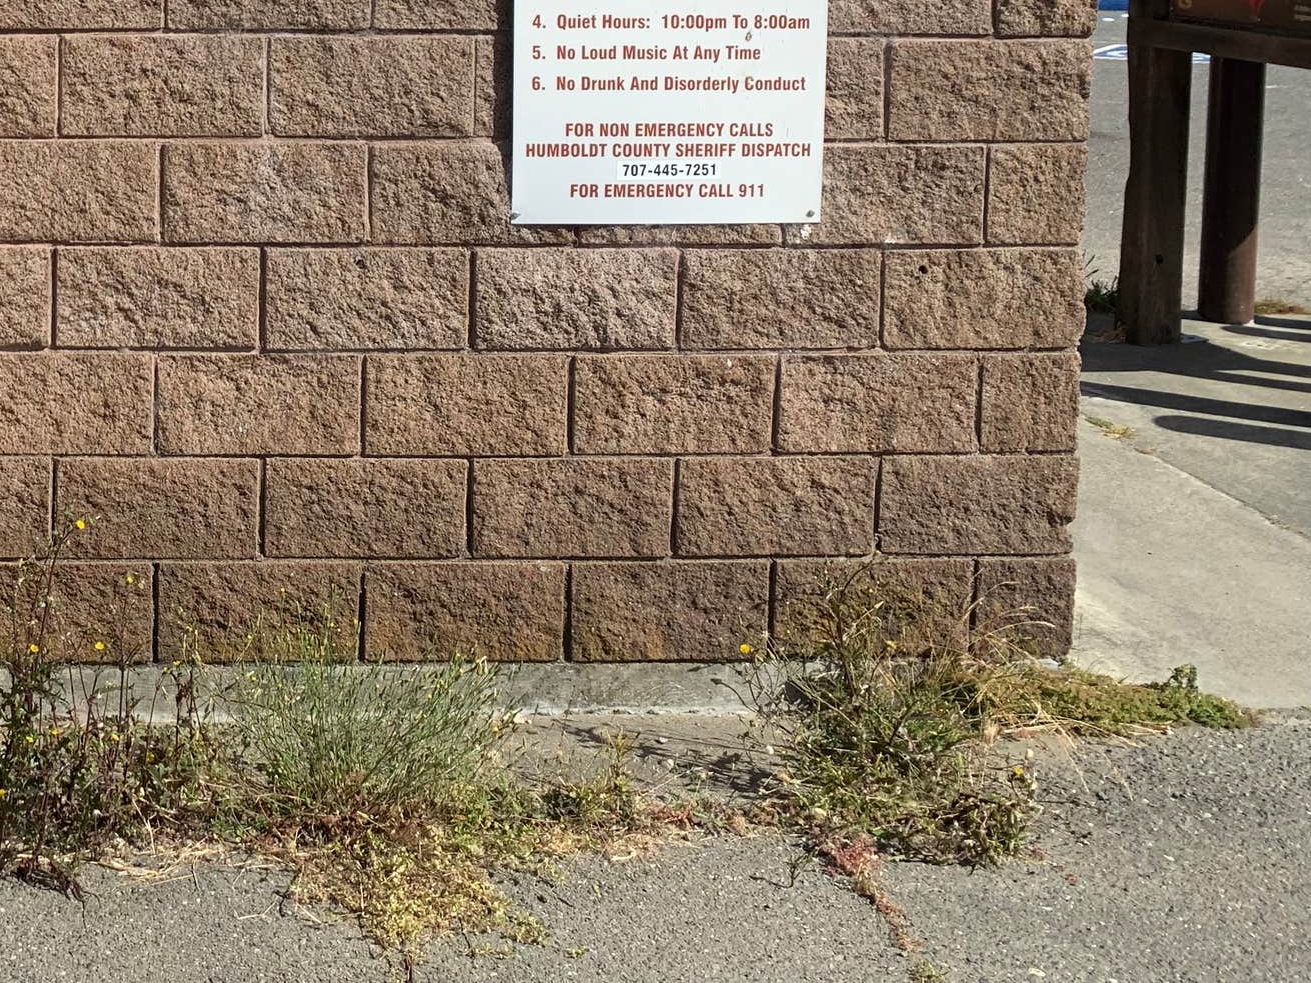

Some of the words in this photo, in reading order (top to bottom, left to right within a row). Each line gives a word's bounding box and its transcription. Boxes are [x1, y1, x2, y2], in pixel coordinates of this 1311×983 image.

[532, 14, 546, 28] 4.
[557, 13, 596, 30] Quiet
[602, 14, 650, 29] Hours:
[661, 14, 726, 32] 10:00pm
[732, 14, 751, 29] To
[753, 14, 809, 29] 8:00am
[532, 45, 545, 60] 5.
[556, 45, 575, 60] No
[581, 45, 616, 60] Loud
[622, 44, 667, 60] Music
[672, 45, 688, 60] At
[693, 45, 720, 63] Any
[725, 45, 760, 60] Time
[531, 76, 545, 91] 6.
[556, 76, 575, 91] No
[581, 75, 625, 91] Drunk
[629, 75, 658, 90] And
[664, 76, 739, 94] Disorderly
[744, 76, 805, 91] Conduct
[565, 122, 593, 137] FOR
[599, 122, 629, 137] NON
[635, 122, 724, 136] EMERGENCY
[729, 122, 773, 137] CALLS
[525, 143, 607, 157] HUMBOLDT
[612, 143, 670, 157] COUNTY
[675, 143, 736, 157] SHERIFF
[741, 143, 810, 157] DISPATCH
[622, 163, 717, 176] 707-445-7251
[570, 183, 598, 197] FOR
[604, 183, 693, 197] EMERGENCY
[698, 183, 733, 197] CALL
[738, 183, 765, 197] 911
